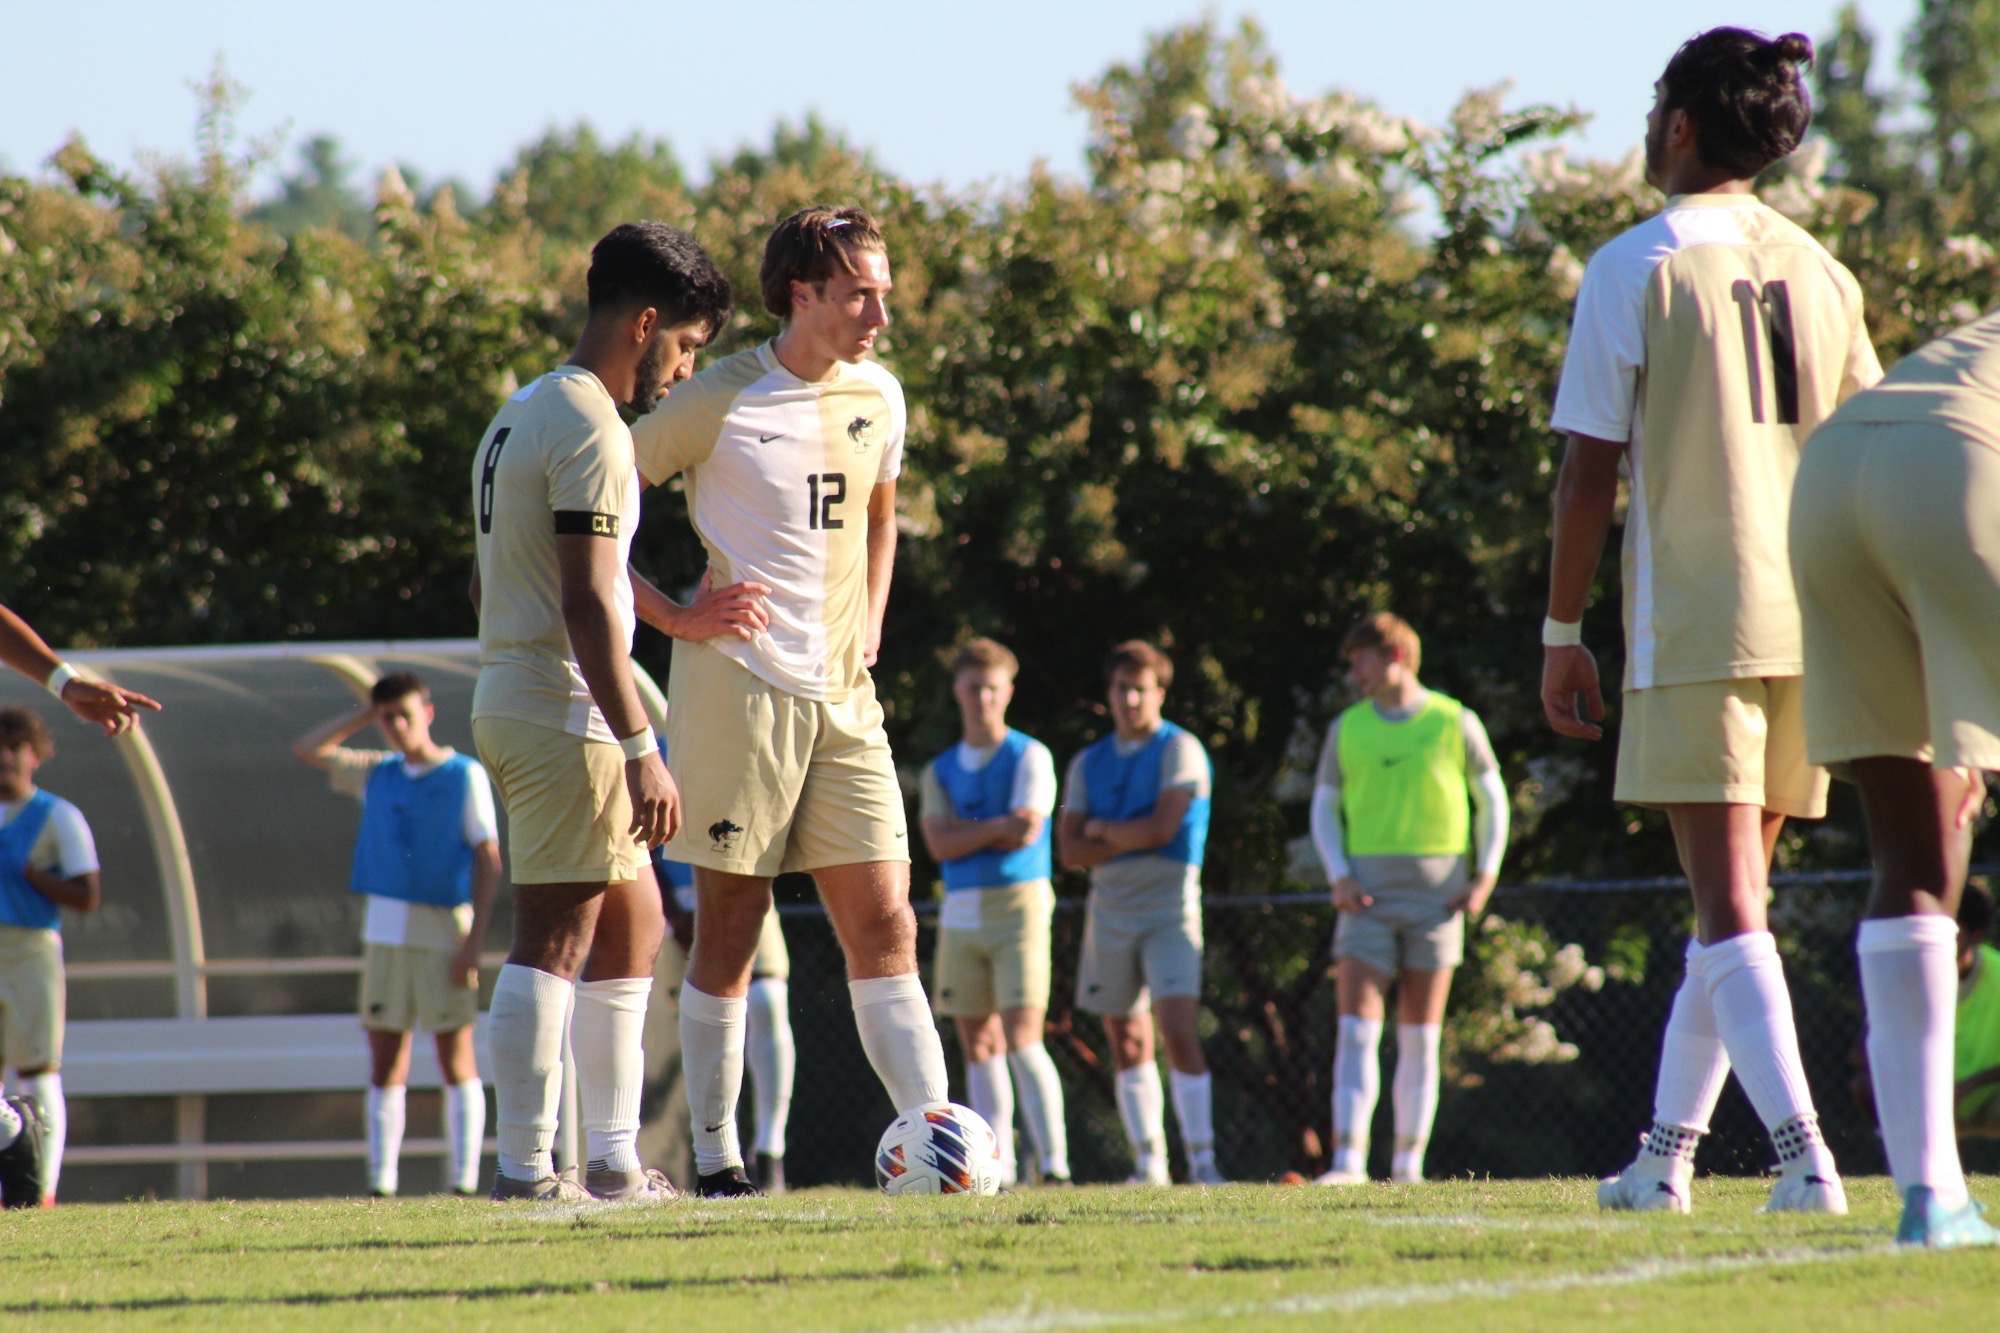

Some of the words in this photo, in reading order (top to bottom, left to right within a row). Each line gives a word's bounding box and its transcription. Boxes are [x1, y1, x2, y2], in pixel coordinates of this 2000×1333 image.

[1731, 279, 1799, 424] 11
[480, 427, 511, 534] 8
[807, 472, 846, 530] 12
